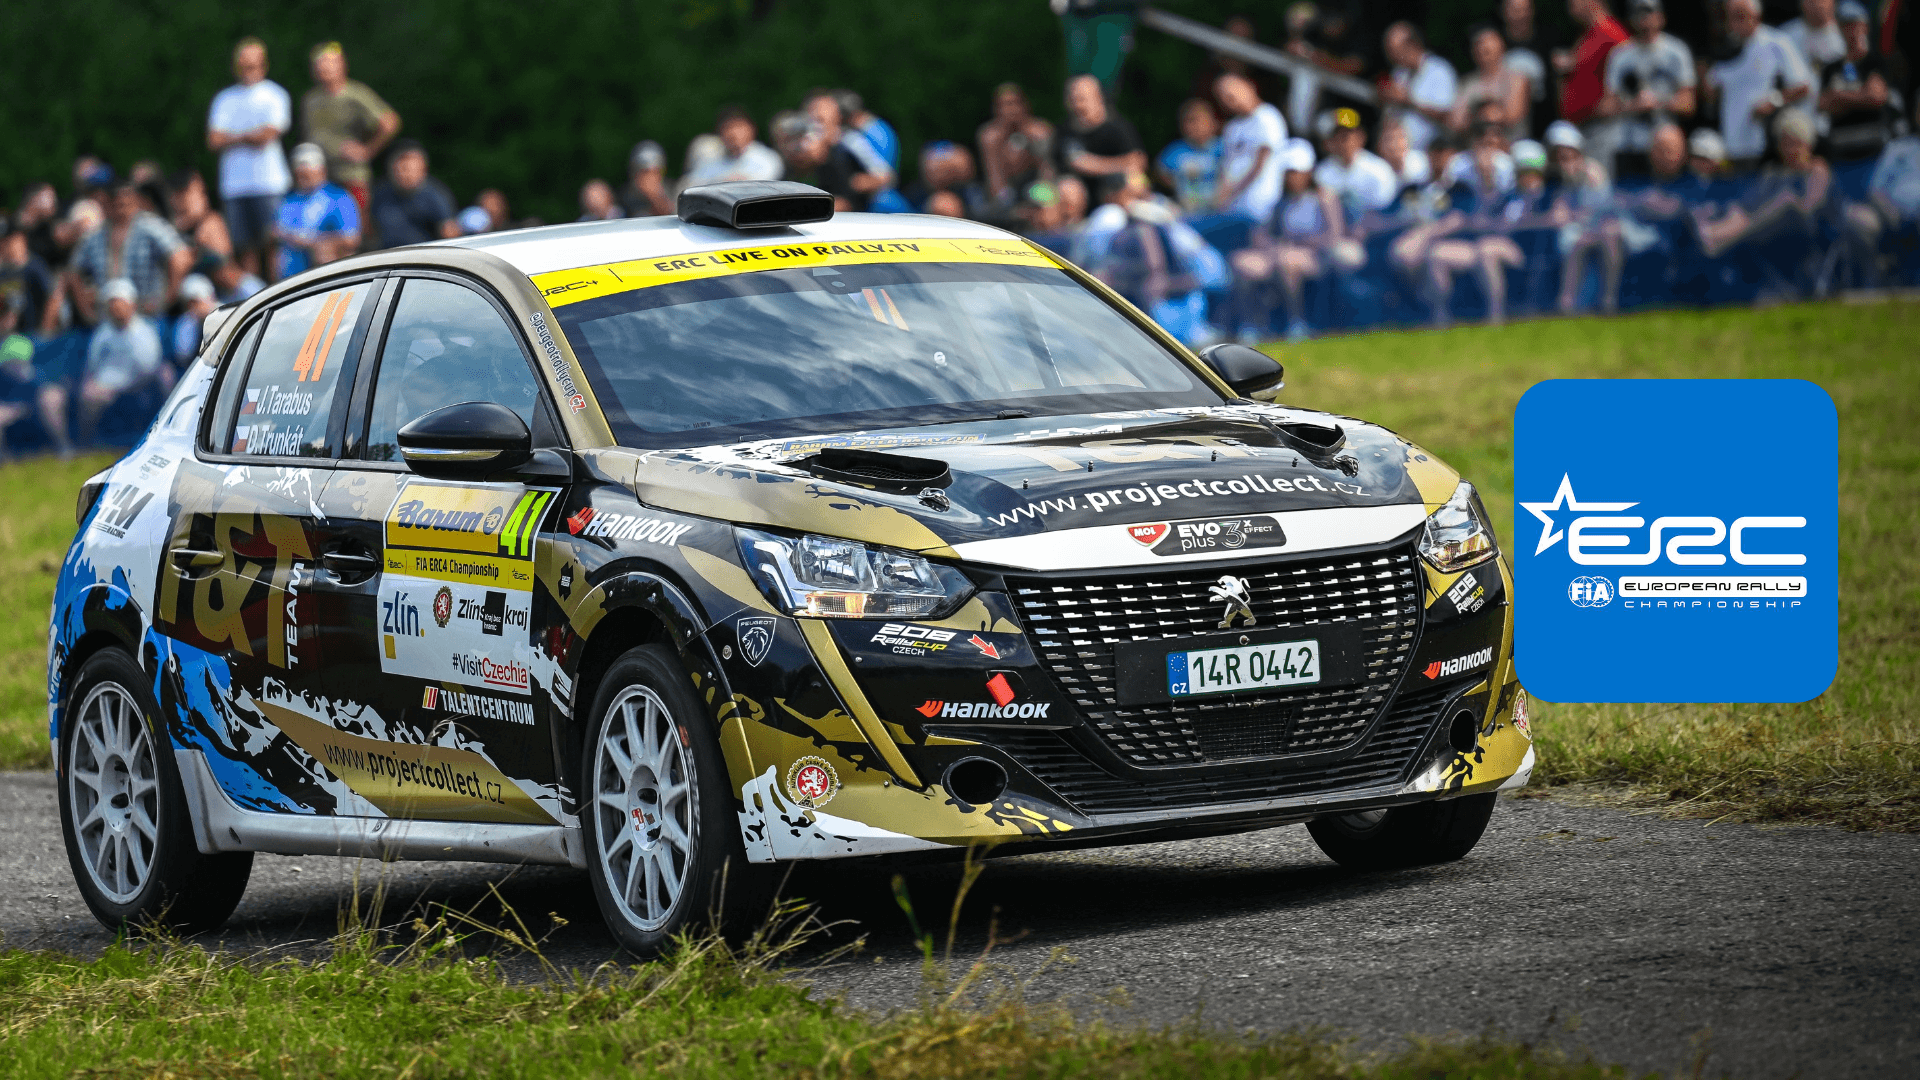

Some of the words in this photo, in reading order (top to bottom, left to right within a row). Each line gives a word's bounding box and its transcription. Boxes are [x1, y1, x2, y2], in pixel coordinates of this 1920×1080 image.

[654, 257, 707, 272] ERC
[708, 250, 768, 265] LIVE
[772, 247, 809, 259] ON
[815, 243, 921, 256] RALLY.TV
[292, 290, 356, 383] 41
[987, 474, 1371, 527] www.projectcollect.cz
[397, 499, 484, 533] Barum
[500, 490, 552, 557] 41
[1176, 521, 1221, 538] EVO
[1243, 525, 1273, 534] EFFECT
[1133, 526, 1157, 537] MOL
[1181, 535, 1216, 552] plus
[415, 557, 428, 572] FIA
[429, 557, 448, 573] ERC4
[449, 560, 499, 581] Championship
[1446, 572, 1478, 605] 208
[286, 562, 305, 670] TEAM
[504, 604, 529, 632] kraj
[740, 619, 774, 627] PEUGEOT
[877, 622, 958, 642] 208
[892, 645, 926, 657] CZECH
[1192, 653, 1242, 688] 14R
[1249, 646, 1314, 682] 0442
[1171, 682, 1188, 695] CZ
[439, 689, 535, 726] TALENTCENTRUM
[323, 743, 505, 805] www.projectcollect.cz
